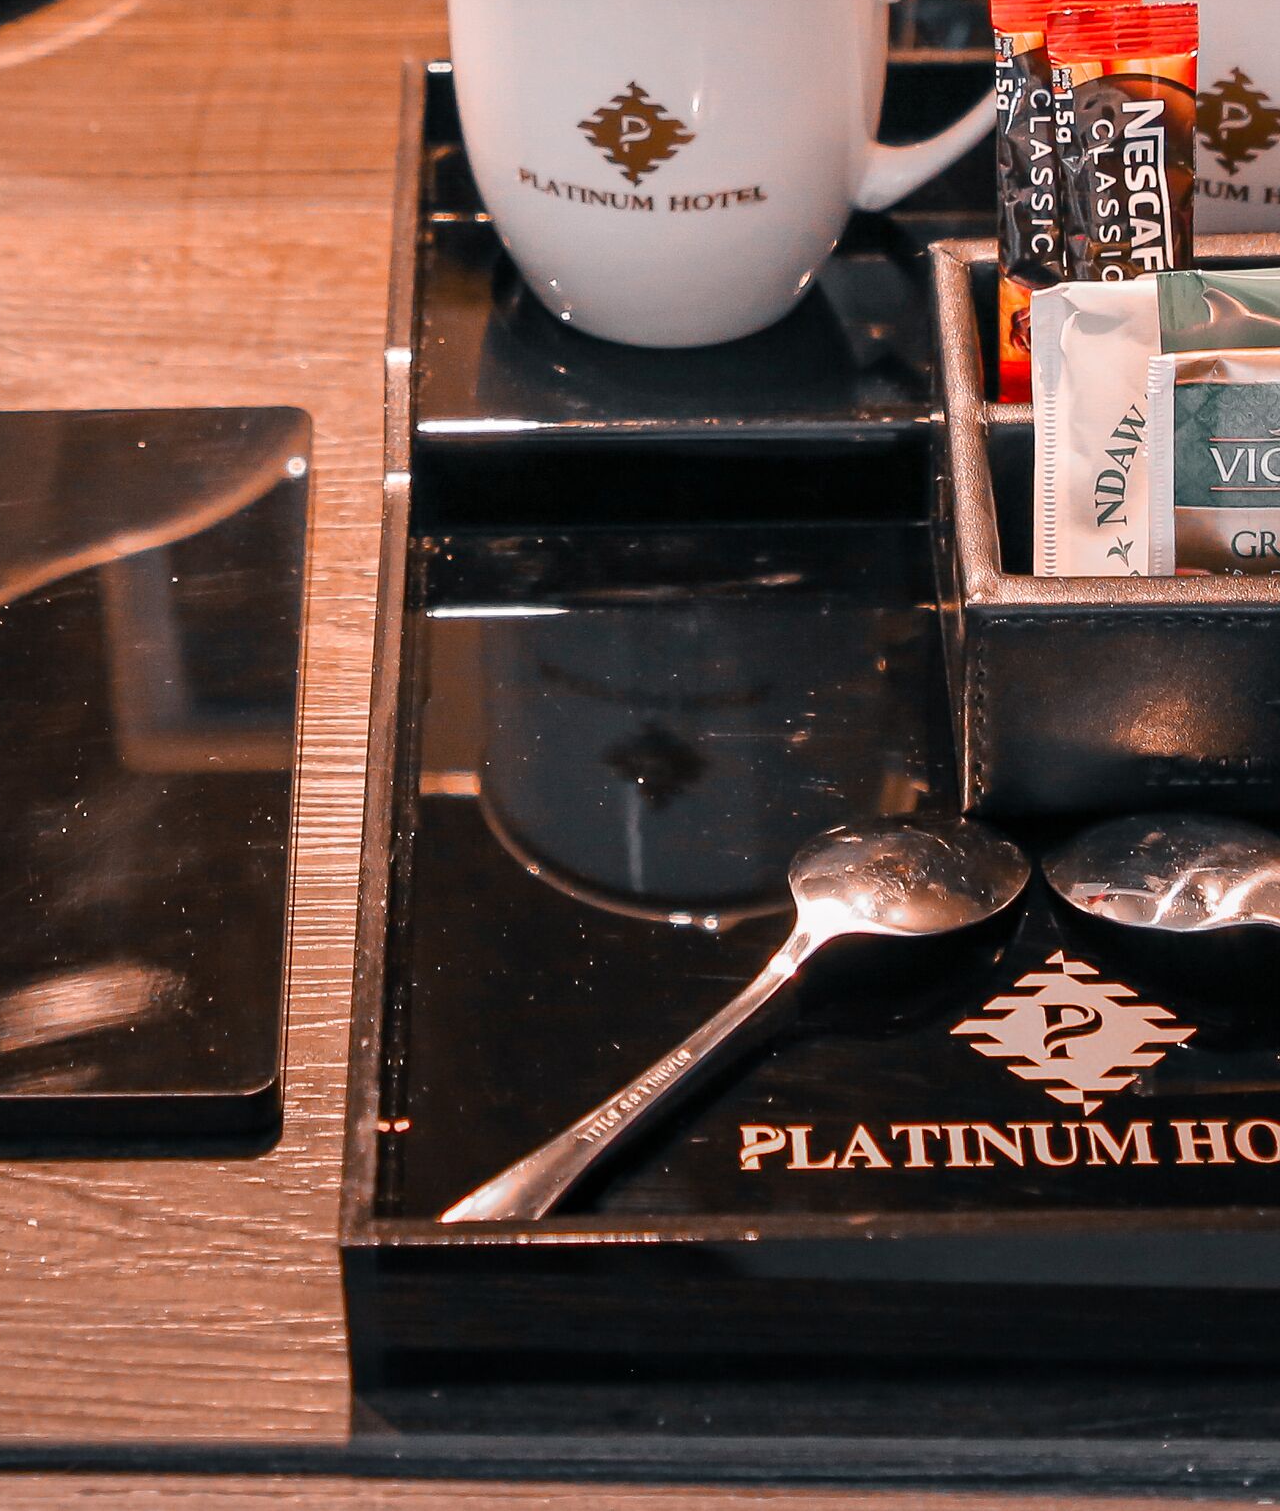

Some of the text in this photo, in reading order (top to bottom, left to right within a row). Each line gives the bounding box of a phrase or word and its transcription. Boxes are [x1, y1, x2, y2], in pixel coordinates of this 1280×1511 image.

[519, 167, 768, 212] PLATINUM HOTEL
[1030, 89, 1054, 254] CLASSIC
[1090, 119, 1124, 282] CLASSIC
[1122, 100, 1174, 271] NESCAF
[1094, 393, 1148, 527] NDAW
[740, 1120, 1159, 1170] PLATINUM
